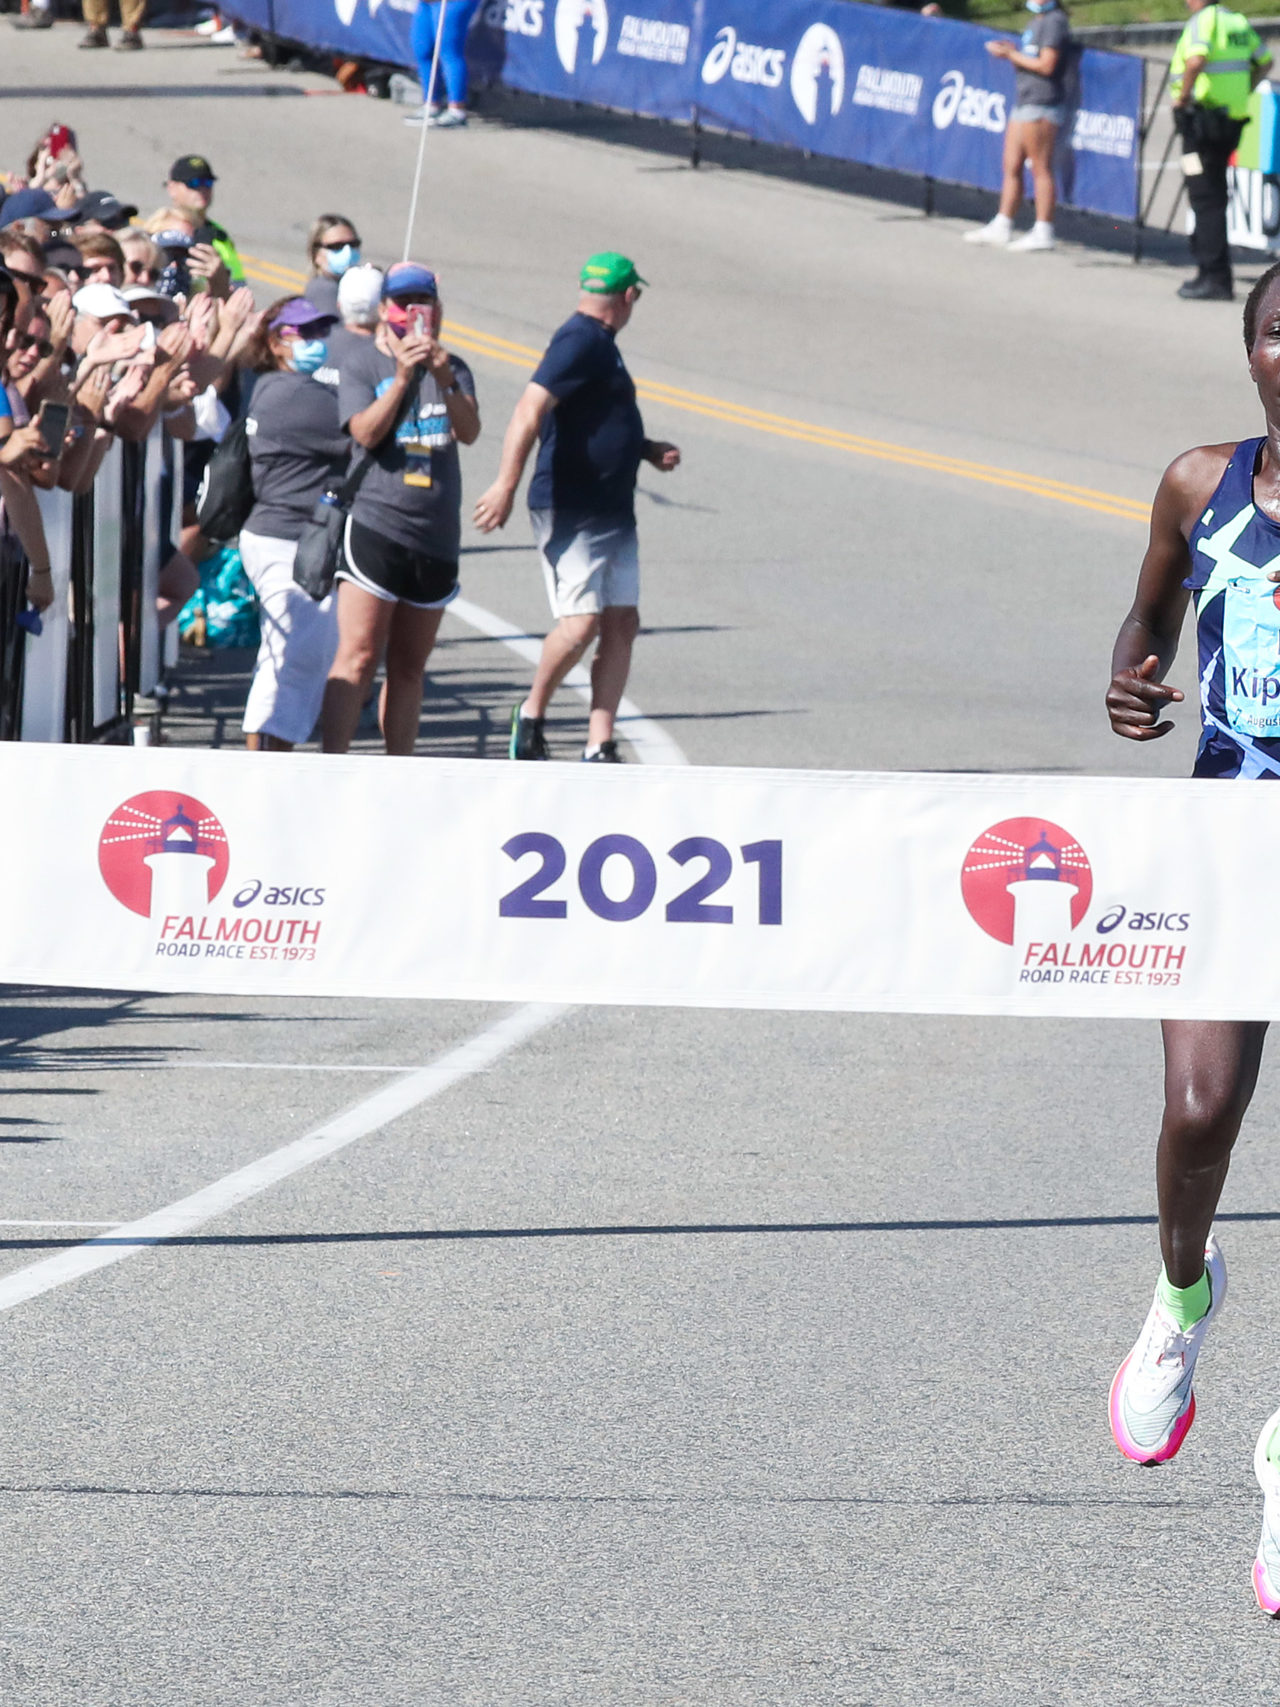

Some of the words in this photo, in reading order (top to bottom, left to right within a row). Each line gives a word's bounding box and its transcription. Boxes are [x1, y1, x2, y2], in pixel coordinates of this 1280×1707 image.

[730, 41, 785, 88] asics
[957, 86, 1007, 133] asics
[499, 832, 782, 925] 2021
[263, 886, 326, 906] asics
[160, 915, 322, 945] FALMOUTH
[1128, 912, 1191, 931] asics
[155, 942, 201, 957] ROAD
[204, 944, 246, 959] RACE
[249, 946, 278, 960] EST.
[282, 947, 316, 961] 1973
[1023, 942, 1187, 970] FALMOUTH
[1019, 969, 1065, 984] ROAD
[1069, 970, 1111, 984] RACE
[1114, 971, 1143, 985] EST.
[1148, 972, 1181, 987] 1973
